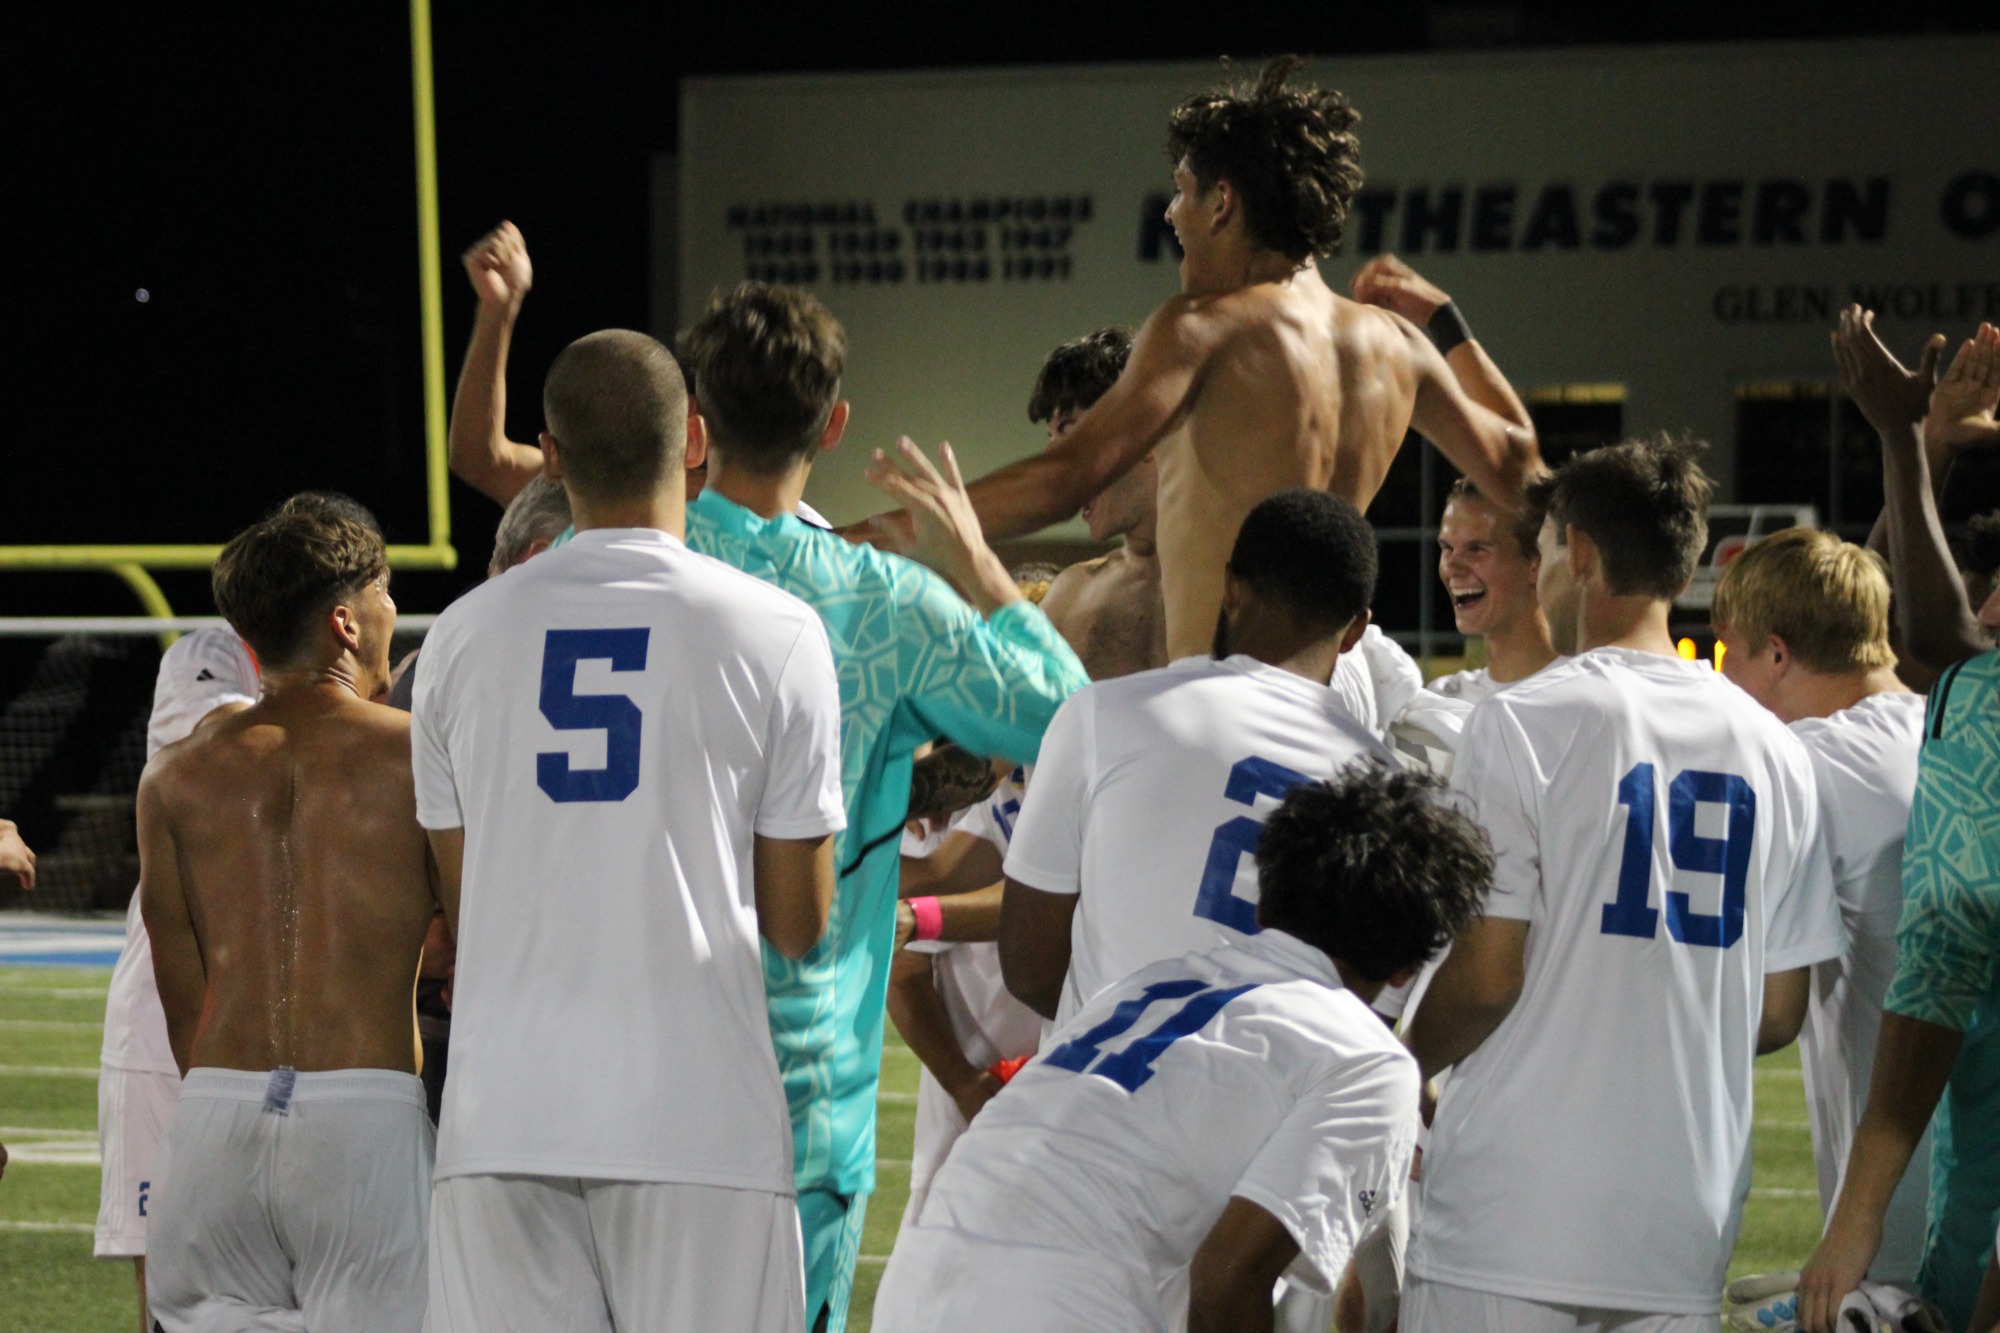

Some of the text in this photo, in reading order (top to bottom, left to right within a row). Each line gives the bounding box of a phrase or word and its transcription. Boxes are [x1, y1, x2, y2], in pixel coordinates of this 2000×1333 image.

[902, 195, 1093, 223] CHAMPIONS
[1137, 175, 1890, 262] NTHEASTERN
[1712, 283, 1832, 322] GLEN
[536, 627, 650, 803] 5
[1600, 762, 1756, 949] 19
[1041, 979, 1264, 1094] 11
